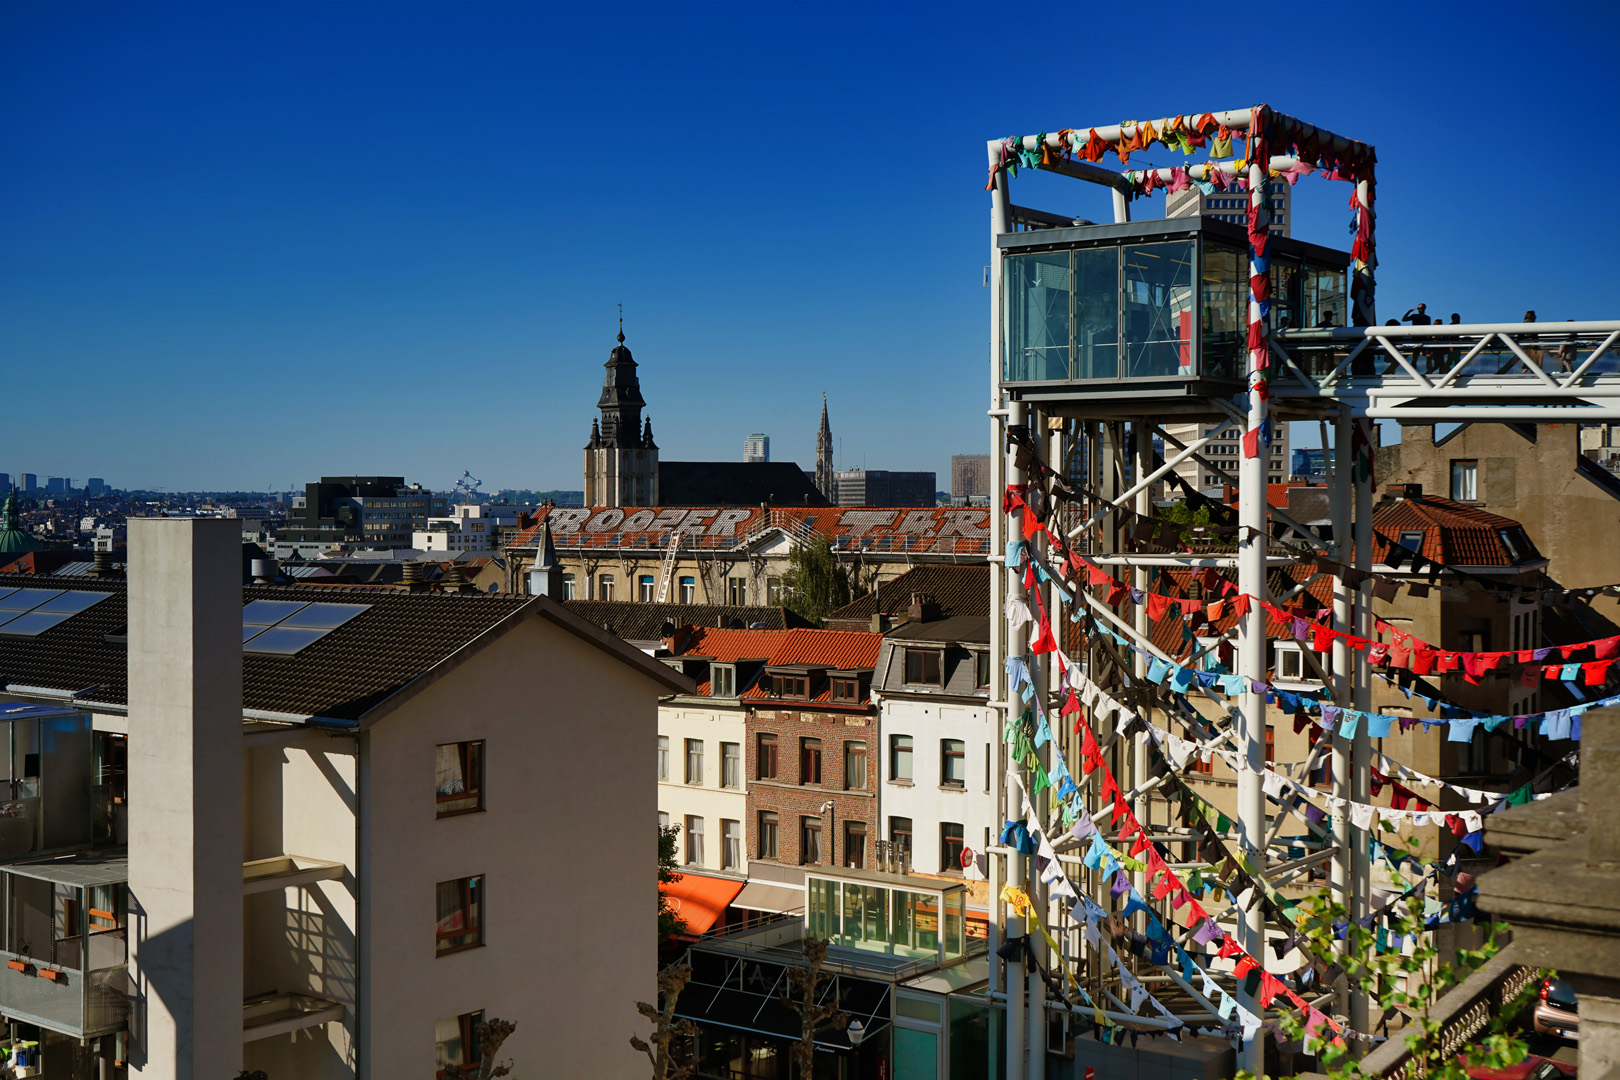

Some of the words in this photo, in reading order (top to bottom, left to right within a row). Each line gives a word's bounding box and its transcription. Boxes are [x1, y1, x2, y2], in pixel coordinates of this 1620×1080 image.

[541, 507, 752, 536] BOOZER
[838, 510, 991, 539] TAR
[1015, 894, 1024, 907] 18
[724, 958, 853, 1002] L'Asceseur
